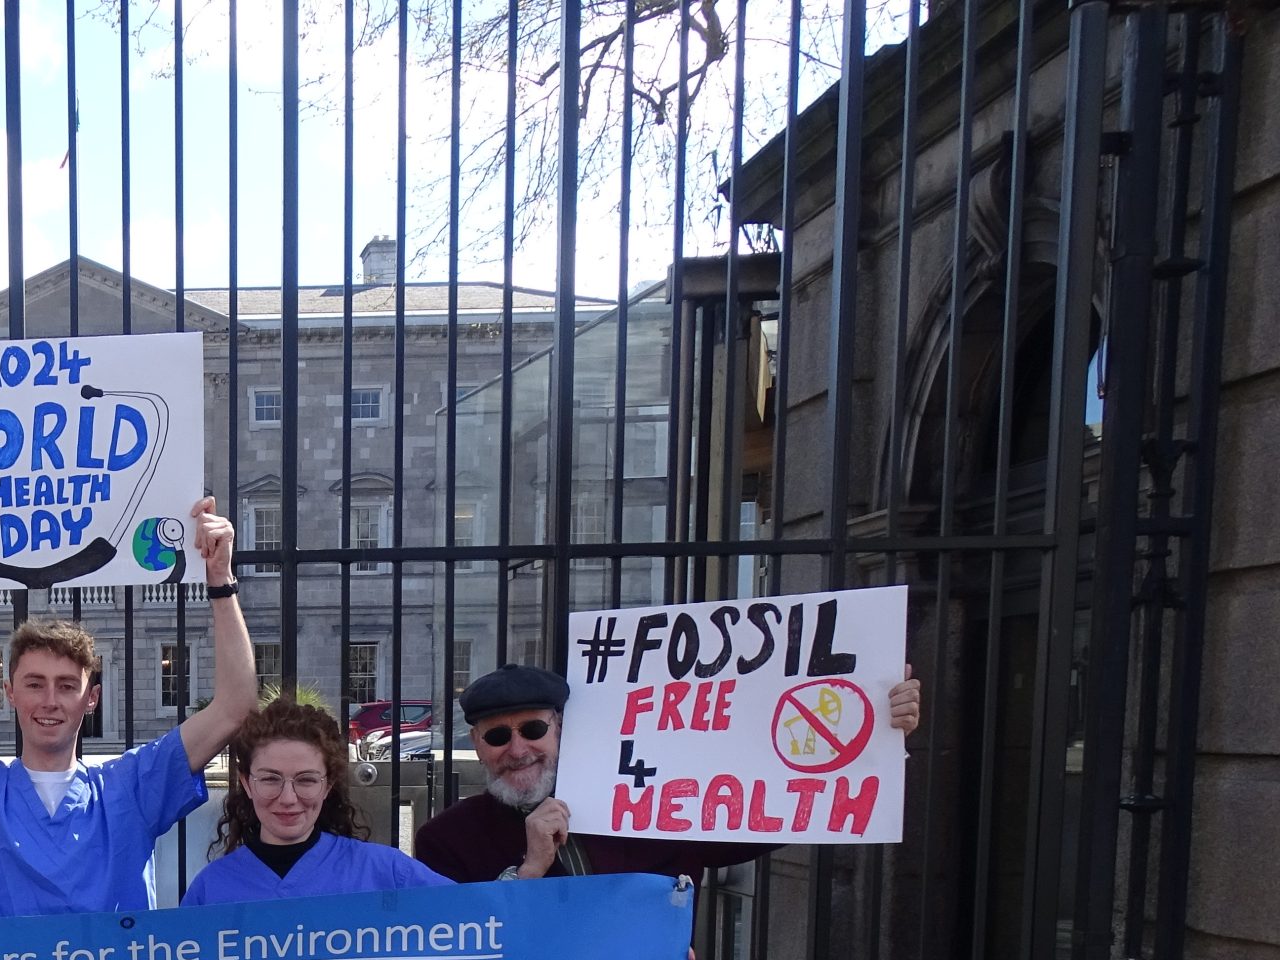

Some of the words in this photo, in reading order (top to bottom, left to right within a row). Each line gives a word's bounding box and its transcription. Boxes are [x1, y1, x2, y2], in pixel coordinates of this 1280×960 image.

[0, 507, 92, 558] DAY
[577, 599, 857, 684] #FOSSIL
[620, 679, 737, 735] FREE
[618, 740, 657, 788] 4
[611, 774, 880, 837] HEALTH
